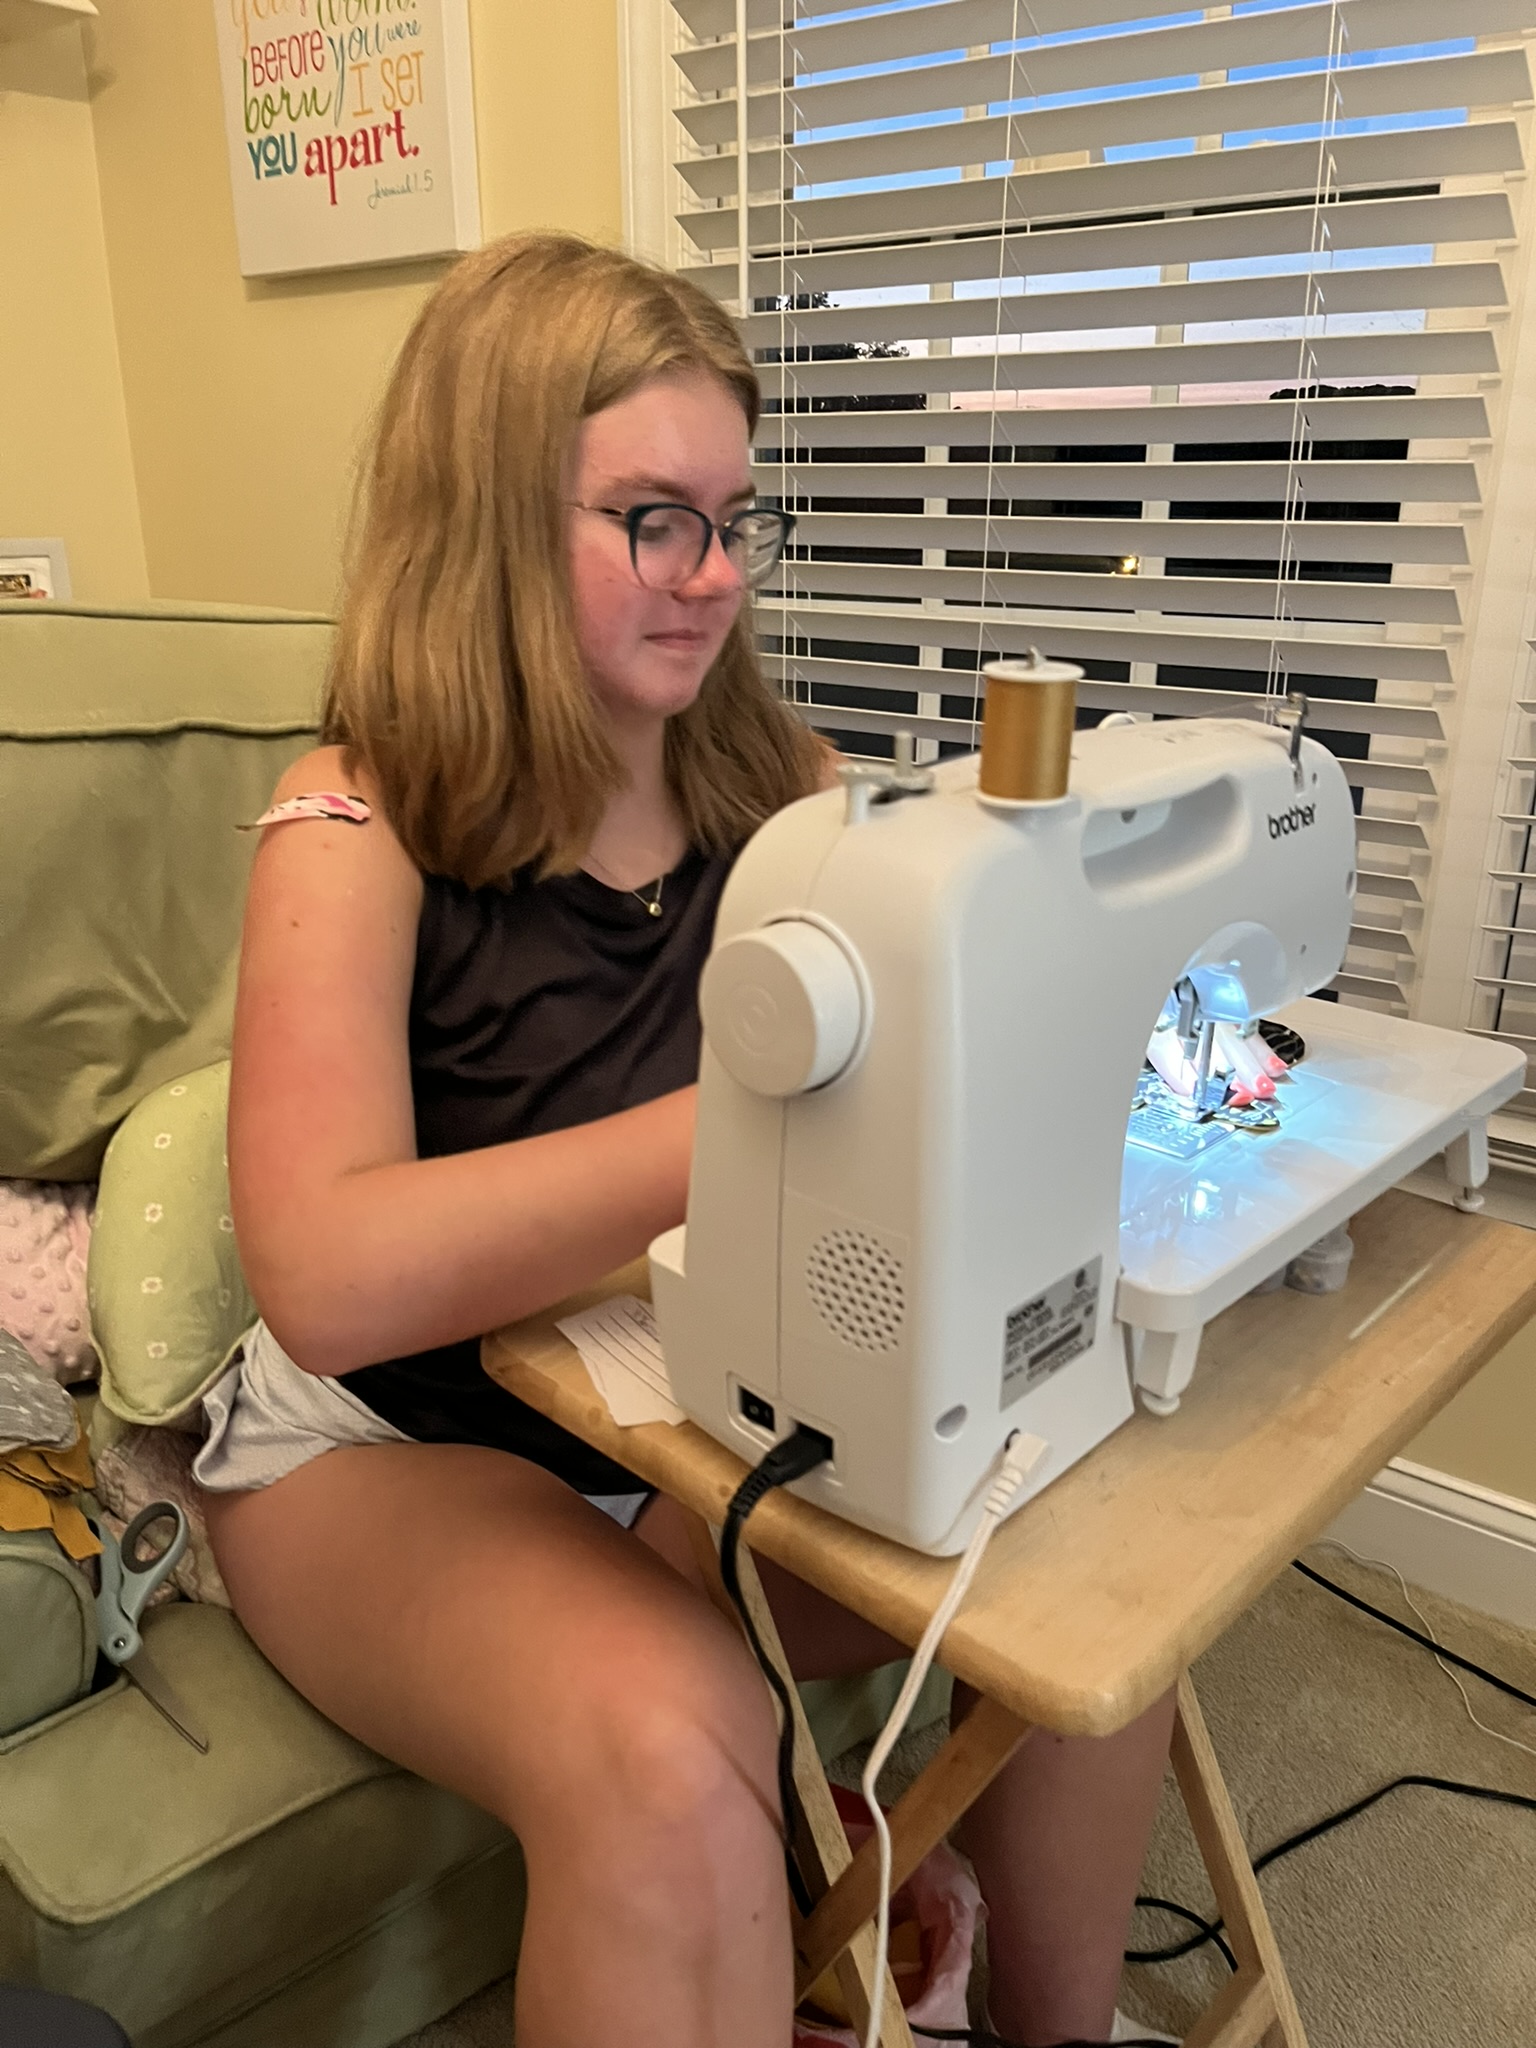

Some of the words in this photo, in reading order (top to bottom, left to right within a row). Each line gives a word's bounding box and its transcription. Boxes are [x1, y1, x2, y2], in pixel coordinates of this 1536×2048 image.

[243, 58, 331, 134] born
[350, 62, 373, 117] I
[327, 22, 383, 128] you
[387, 19, 421, 42] were
[248, 132, 297, 180] YOU
[304, 109, 420, 206] apart.
[1267, 803, 1316, 839] brother
